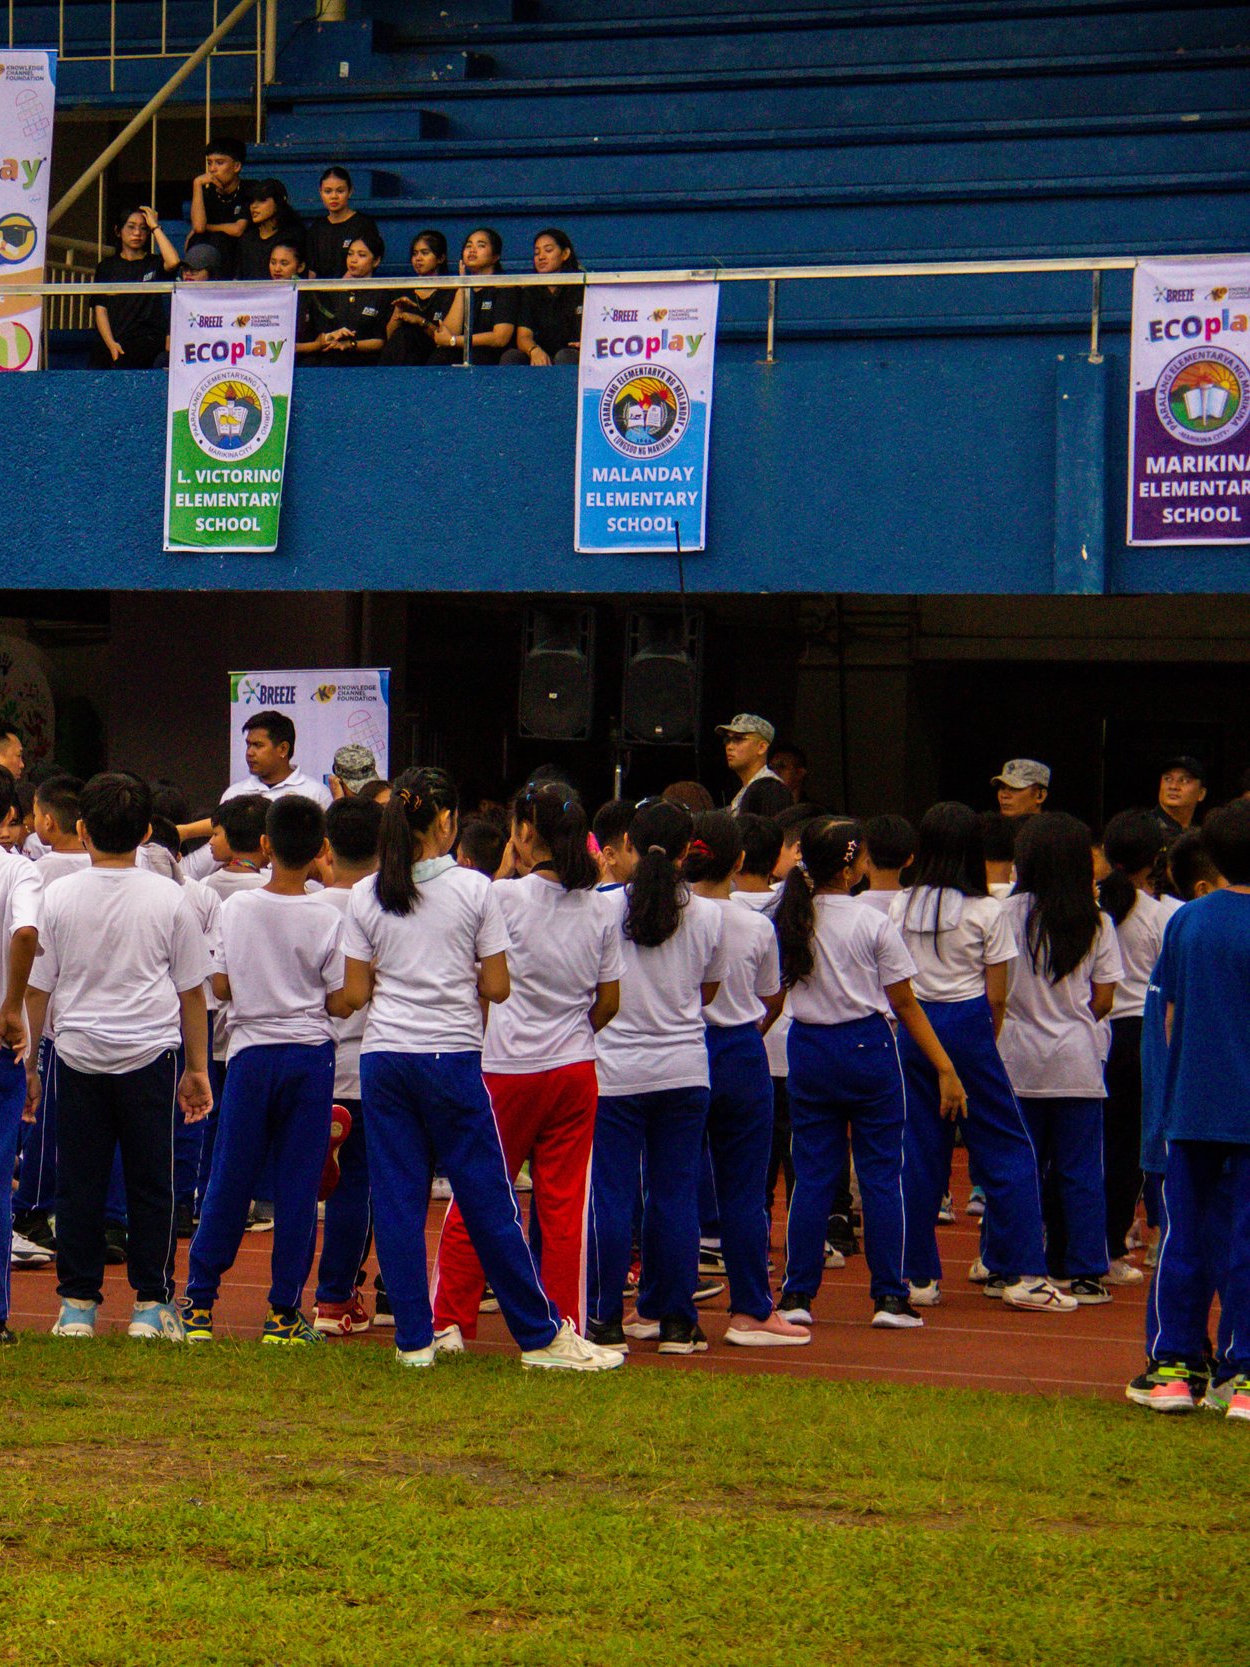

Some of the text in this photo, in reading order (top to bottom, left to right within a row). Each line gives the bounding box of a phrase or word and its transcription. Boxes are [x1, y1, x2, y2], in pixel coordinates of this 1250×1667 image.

[1166, 288, 1195, 302] BREEZE
[198, 315, 223, 328] BREEZE
[612, 309, 639, 322] BREEZE
[1149, 308, 1250, 342] ECOpla
[184, 334, 284, 366] ECOplay
[595, 328, 703, 360] ECOplay
[602, 367, 687, 428] PAARALANG ELEMENTARYA NG MALANDAY
[1158, 351, 1250, 431] PAARALANG ELEMENTARYA NG MARIKINA
[261, 393, 270, 435] VICTORINO
[208, 445, 253, 458] MARIKINA CITY
[613, 434, 675, 455] LUNGSOD NG MARIKINA
[177, 469, 281, 483] L. VICTORINO
[592, 466, 694, 482] MALANDAY
[175, 492, 279, 507] ELEMENTARY
[585, 491, 698, 507] ELEMENTARY
[1162, 506, 1242, 524] SCHOOL
[195, 517, 261, 532] SCHOOL
[607, 517, 676, 532] SCHOOL
[260, 685, 297, 705] BREEZE
